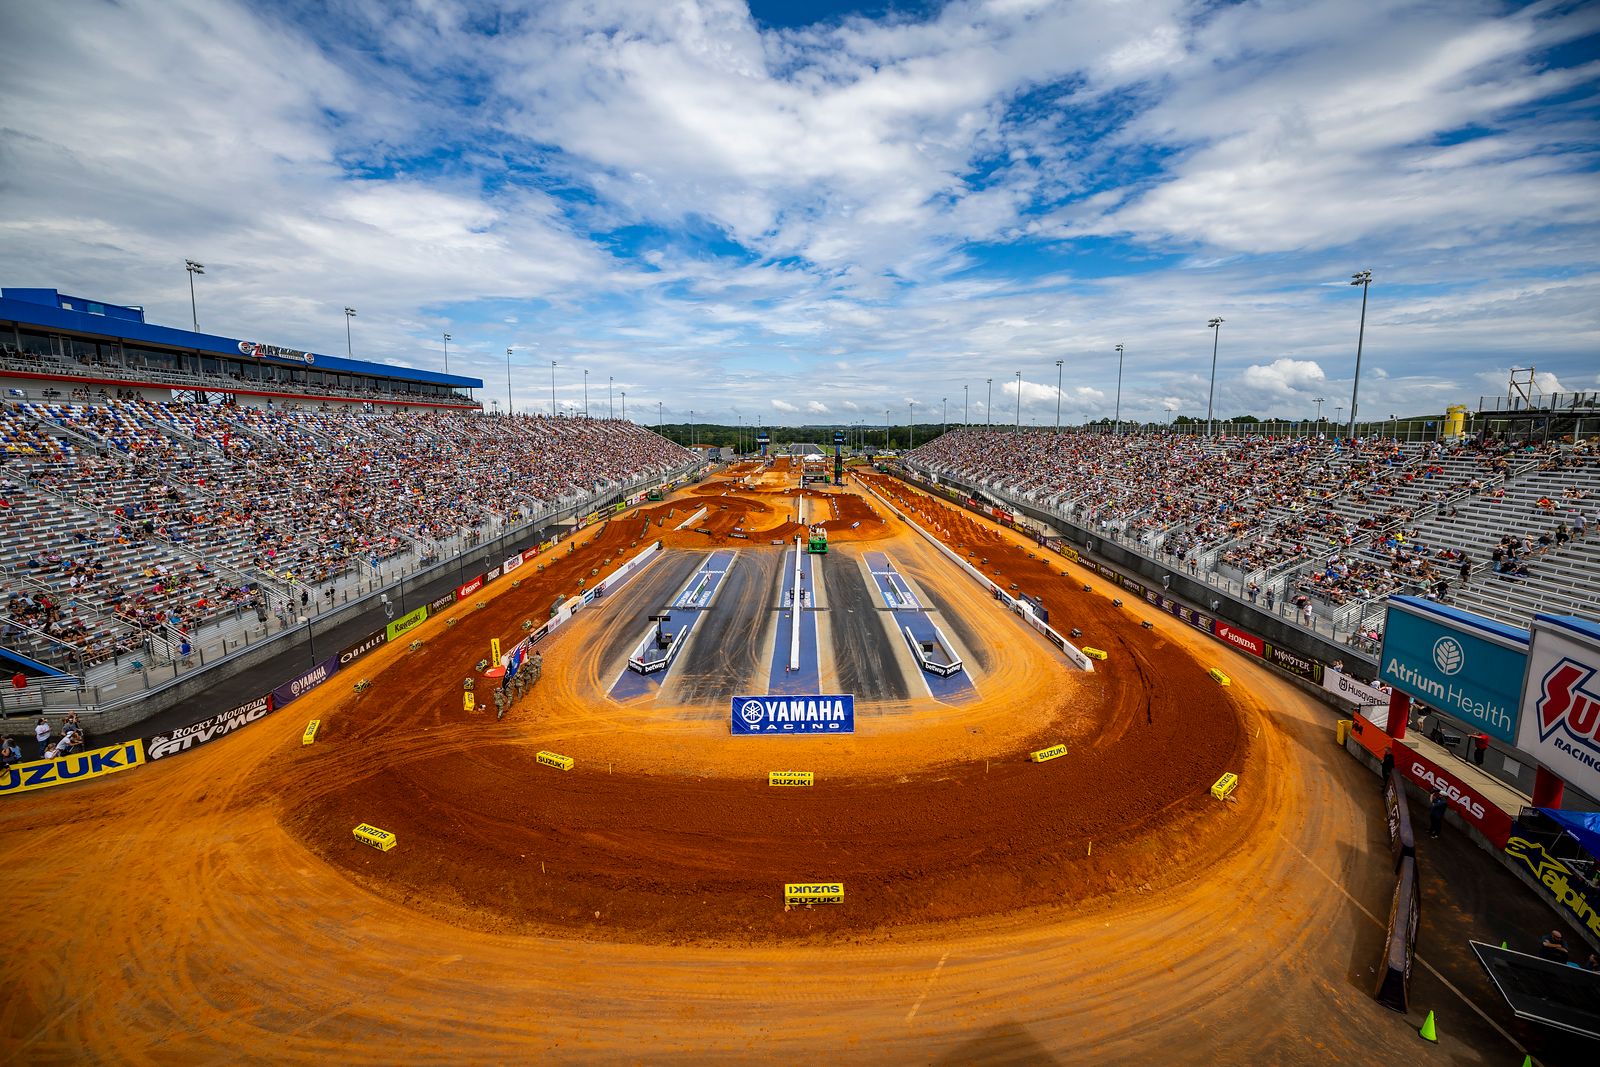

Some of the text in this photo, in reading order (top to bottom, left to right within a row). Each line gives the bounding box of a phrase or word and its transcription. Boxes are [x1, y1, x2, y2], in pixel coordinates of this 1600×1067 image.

[394, 611, 421, 633] Kawasaki
[353, 632, 386, 657] OAKLEY
[1228, 632, 1257, 651] HONDA
[645, 661, 666, 673] betway
[925, 662, 946, 676] betway
[1274, 649, 1310, 672] MONSTER
[298, 665, 326, 691] YAMAHA
[1386, 658, 1511, 732] Atrium Health
[171, 697, 267, 740] ROCKY MOUNTAIN
[765, 701, 845, 721] YAMAHA
[538, 755, 565, 769] SUZUKI
[1039, 746, 1066, 760] SUZUKI
[1411, 762, 1486, 820] GASGAS
[788, 885, 840, 894] SUZUKI
[789, 896, 841, 904] SUZUKI
